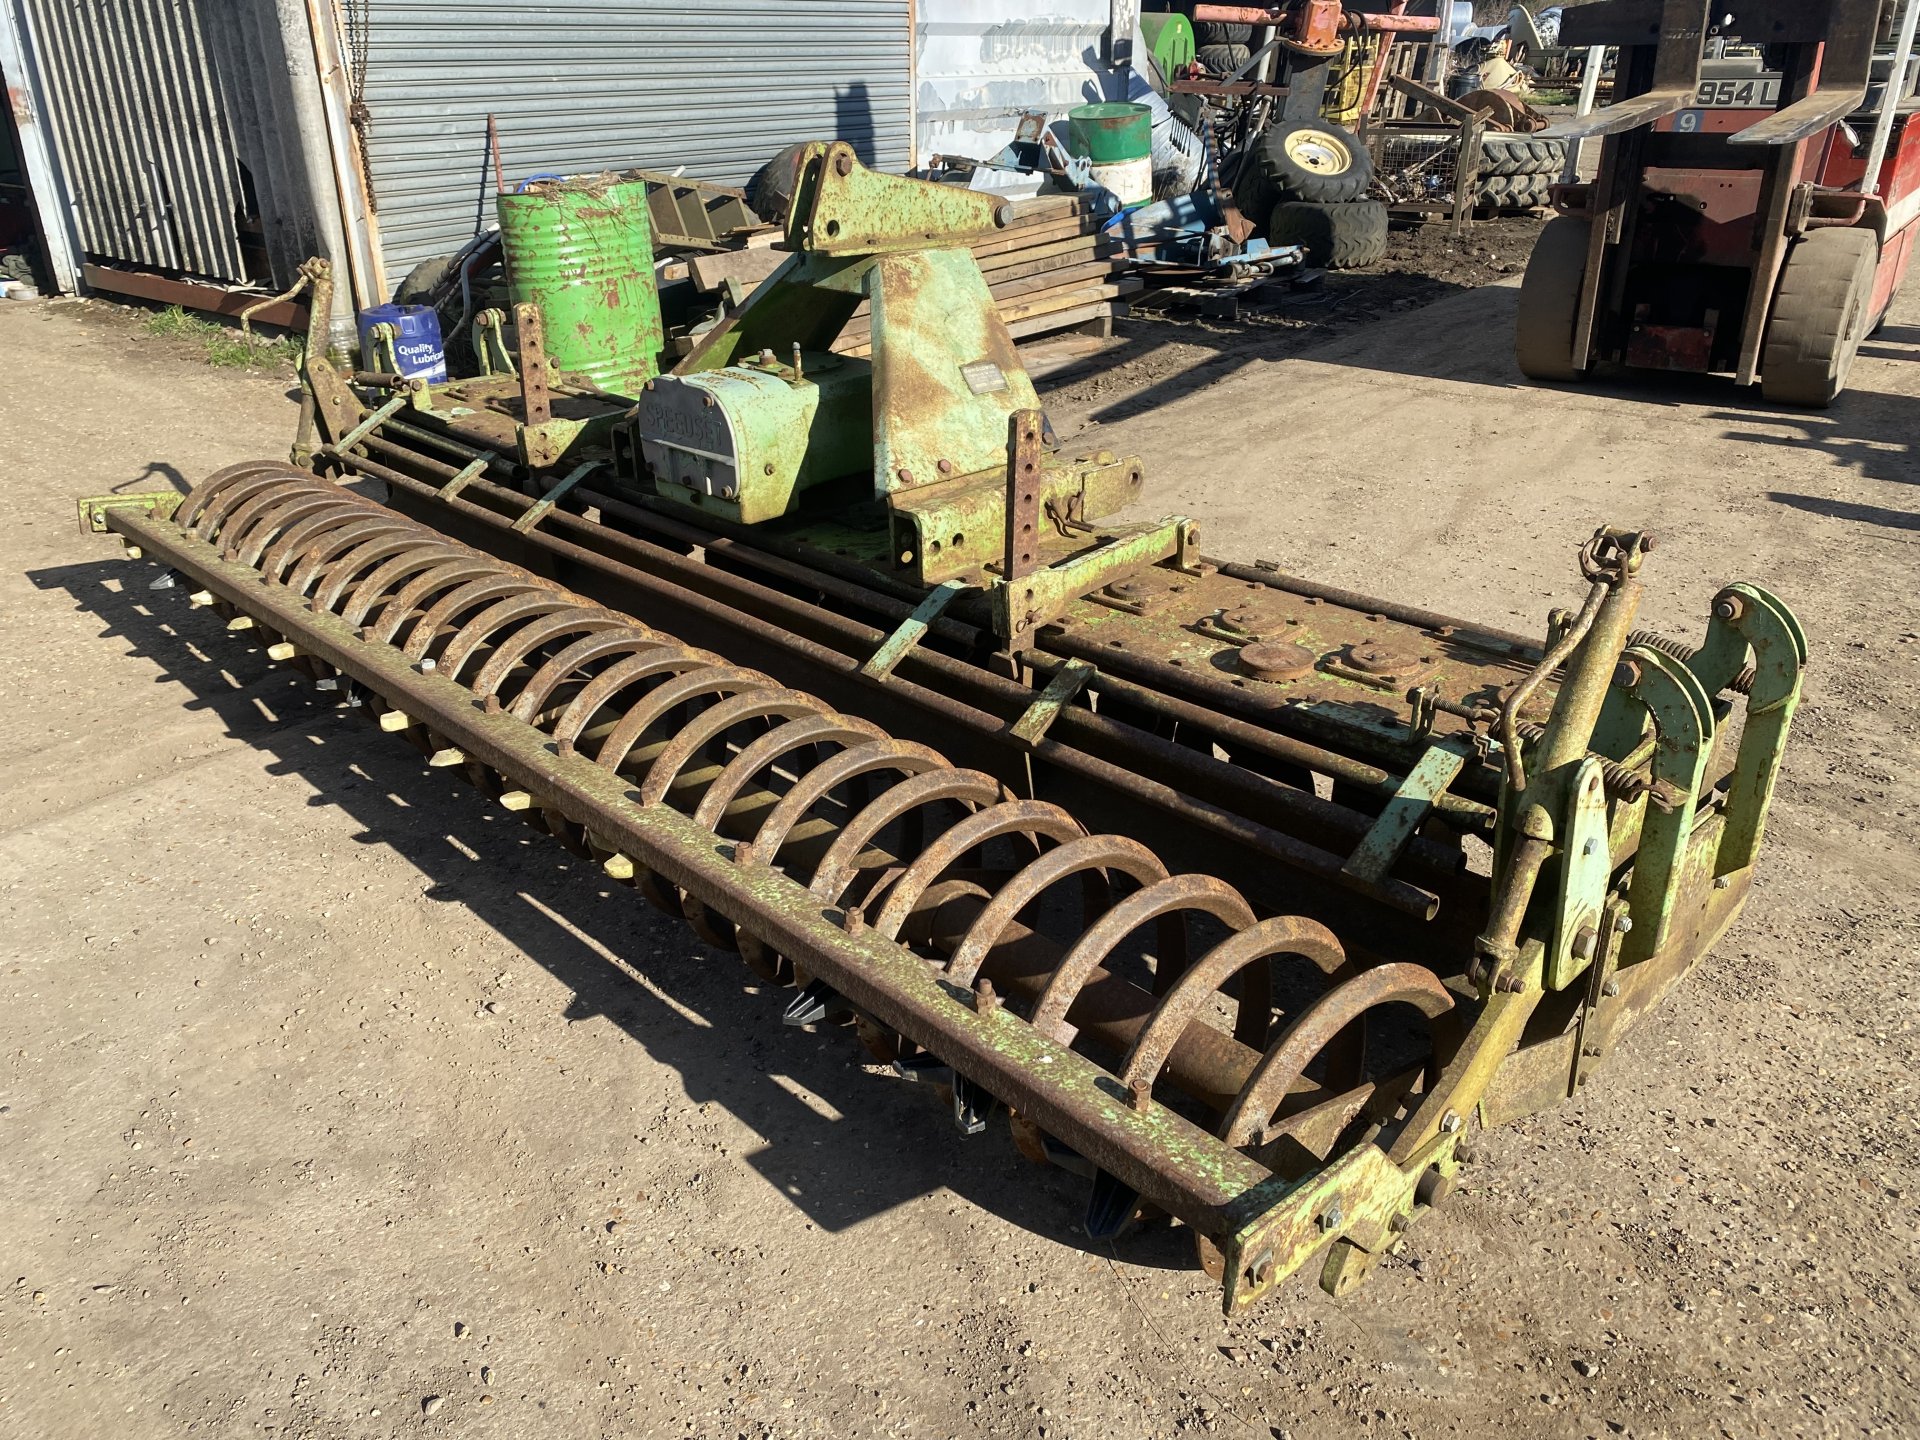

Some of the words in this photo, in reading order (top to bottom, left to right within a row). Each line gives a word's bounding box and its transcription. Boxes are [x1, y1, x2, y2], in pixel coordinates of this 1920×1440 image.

[1697, 82, 1755, 105] 954
[1680, 113, 1696, 132] 9
[398, 343, 433, 356] Quality
